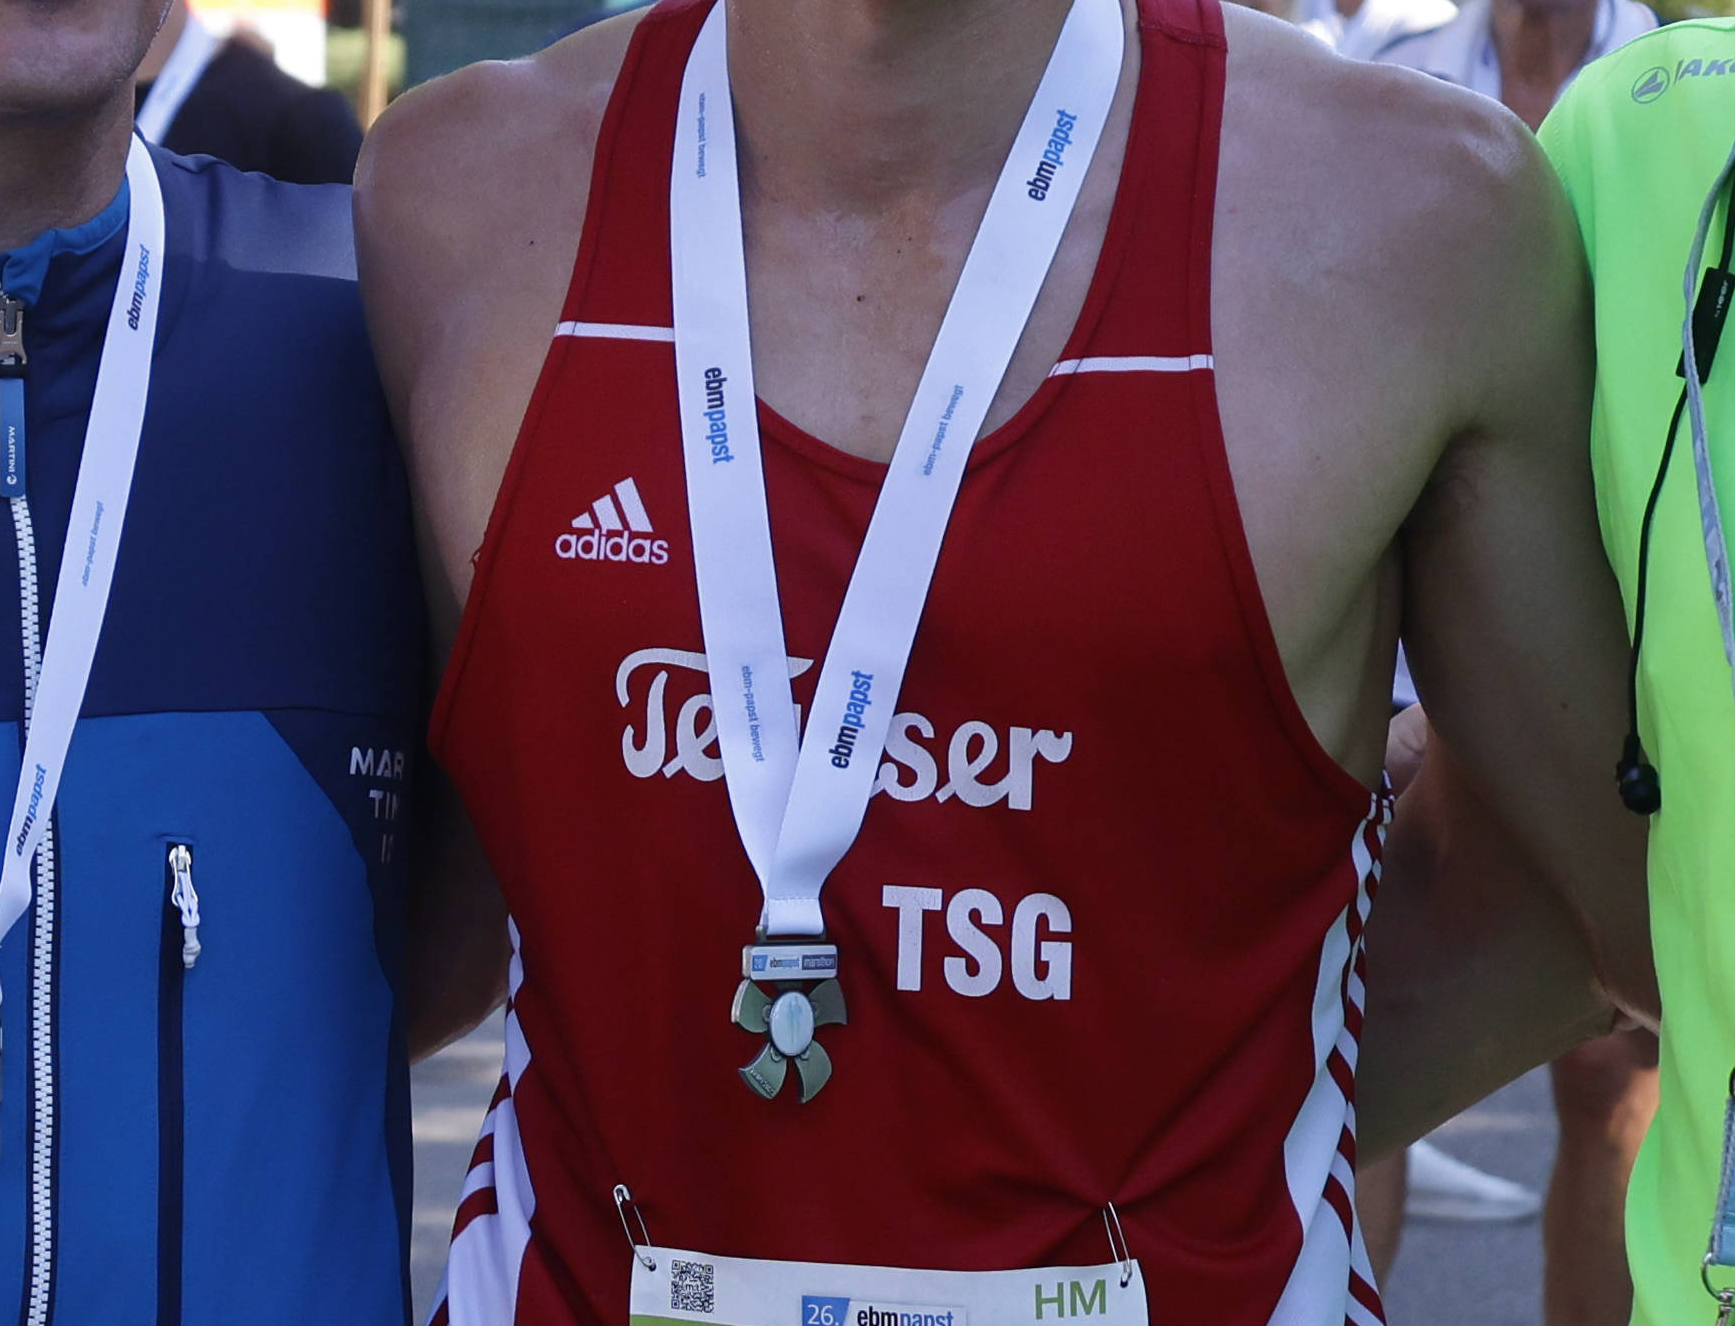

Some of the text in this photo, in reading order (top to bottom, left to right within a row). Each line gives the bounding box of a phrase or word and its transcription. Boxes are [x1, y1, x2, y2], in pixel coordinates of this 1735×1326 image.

[1027, 109, 1078, 202] ebmpapst
[127, 243, 150, 331] ebmpapst
[8, 426, 16, 473] MARTINI
[703, 366, 734, 464] ebmpapst
[555, 529, 669, 565] adidas
[615, 647, 1073, 811] Teser
[831, 670, 874, 769] ebmpapst
[881, 884, 1073, 1001] TSG
[807, 1303, 840, 1326] 26.
[1034, 1279, 1107, 1320] HM
